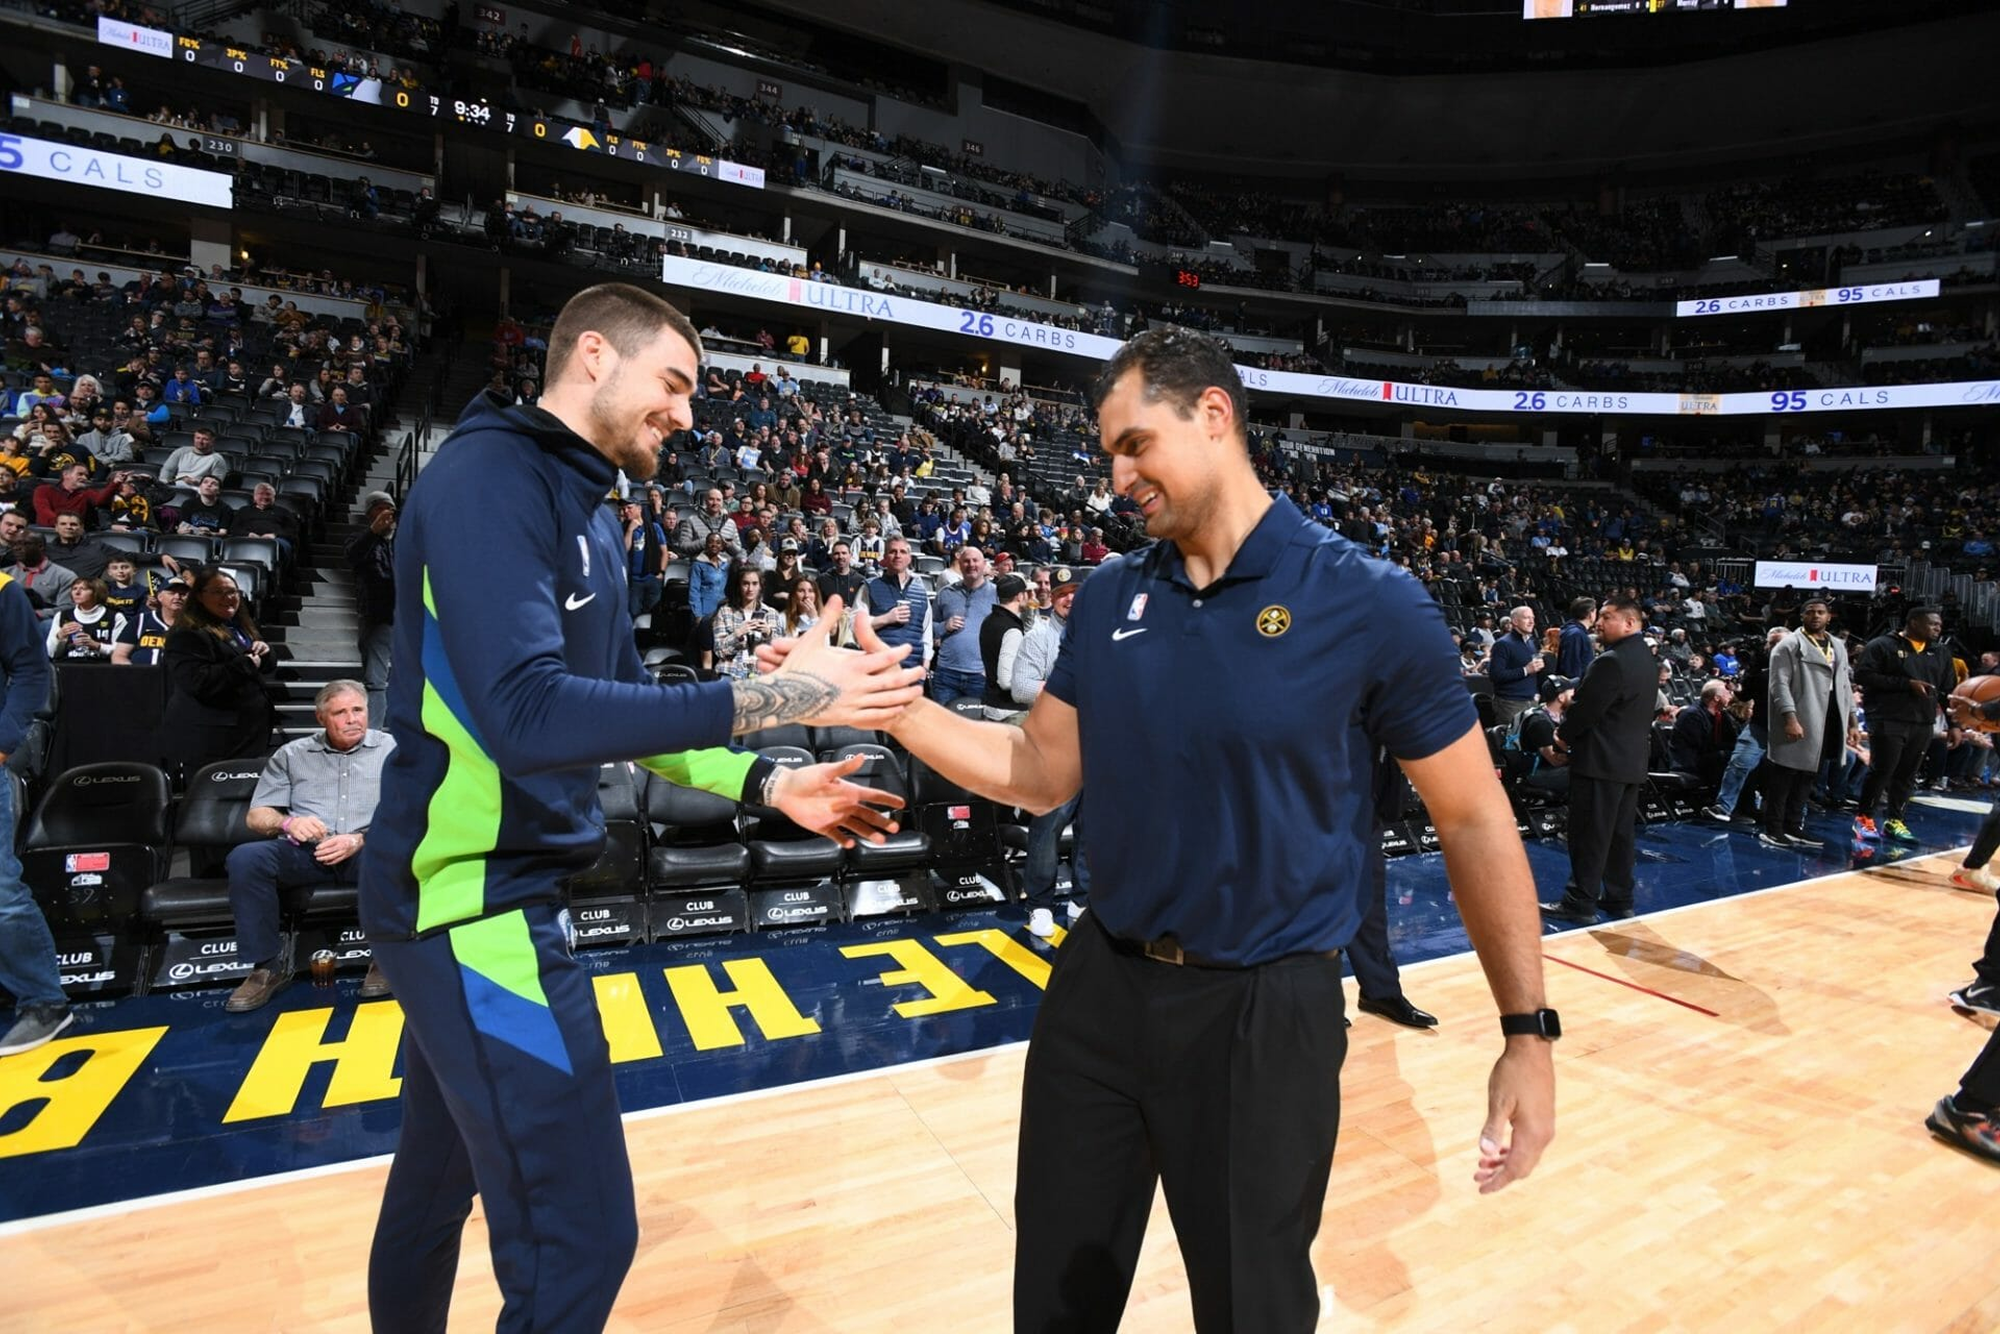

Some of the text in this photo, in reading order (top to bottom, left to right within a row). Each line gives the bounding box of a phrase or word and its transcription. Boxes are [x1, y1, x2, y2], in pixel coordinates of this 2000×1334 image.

[185, 50, 195, 62] 0
[234, 61, 244, 73] 0
[310, 67, 325, 79] FLS
[275, 71, 285, 82] 0
[314, 80, 323, 91] 0
[397, 92, 408, 107] 0
[430, 105, 438, 116] 7
[454, 100, 491, 121] 9:34
[506, 122, 514, 133] 7
[535, 123, 546, 137] 0
[208, 140, 233, 152] 230
[608, 145, 616, 155] 0
[636, 151, 644, 162] 0
[50, 151, 163, 189] CALS
[671, 159, 679, 169] 0
[700, 165, 708, 176] 0
[670, 228, 688, 240] 232
[1728, 296, 1789, 310] CARBS
[1838, 287, 1864, 301] 95
[1872, 284, 1921, 298] CALS
[807, 284, 894, 318] ULTRA
[959, 311, 994, 338] 2.6
[1005, 322, 1076, 349] CARBS
[1239, 369, 1268, 387] ALS
[1396, 385, 1459, 406] ULTRA
[1513, 391, 1546, 410] 2.6
[1556, 395, 1628, 409] CARBS
[1771, 391, 1807, 411] 95
[1820, 390, 1889, 406] CALS
[1820, 571, 1872, 584] ULTRA
[92, 775, 141, 784] LEXUS
[959, 876, 981, 885] CLUB
[784, 891, 810, 902] CLUB
[686, 901, 714, 911] CLUB
[784, 906, 828, 917] LEXUS
[580, 909, 610, 921] CLUB
[685, 916, 733, 927] LEXUS
[340, 930, 366, 942] CLU
[579, 925, 631, 937] LEXUS
[59, 970, 116, 984] EXUS
